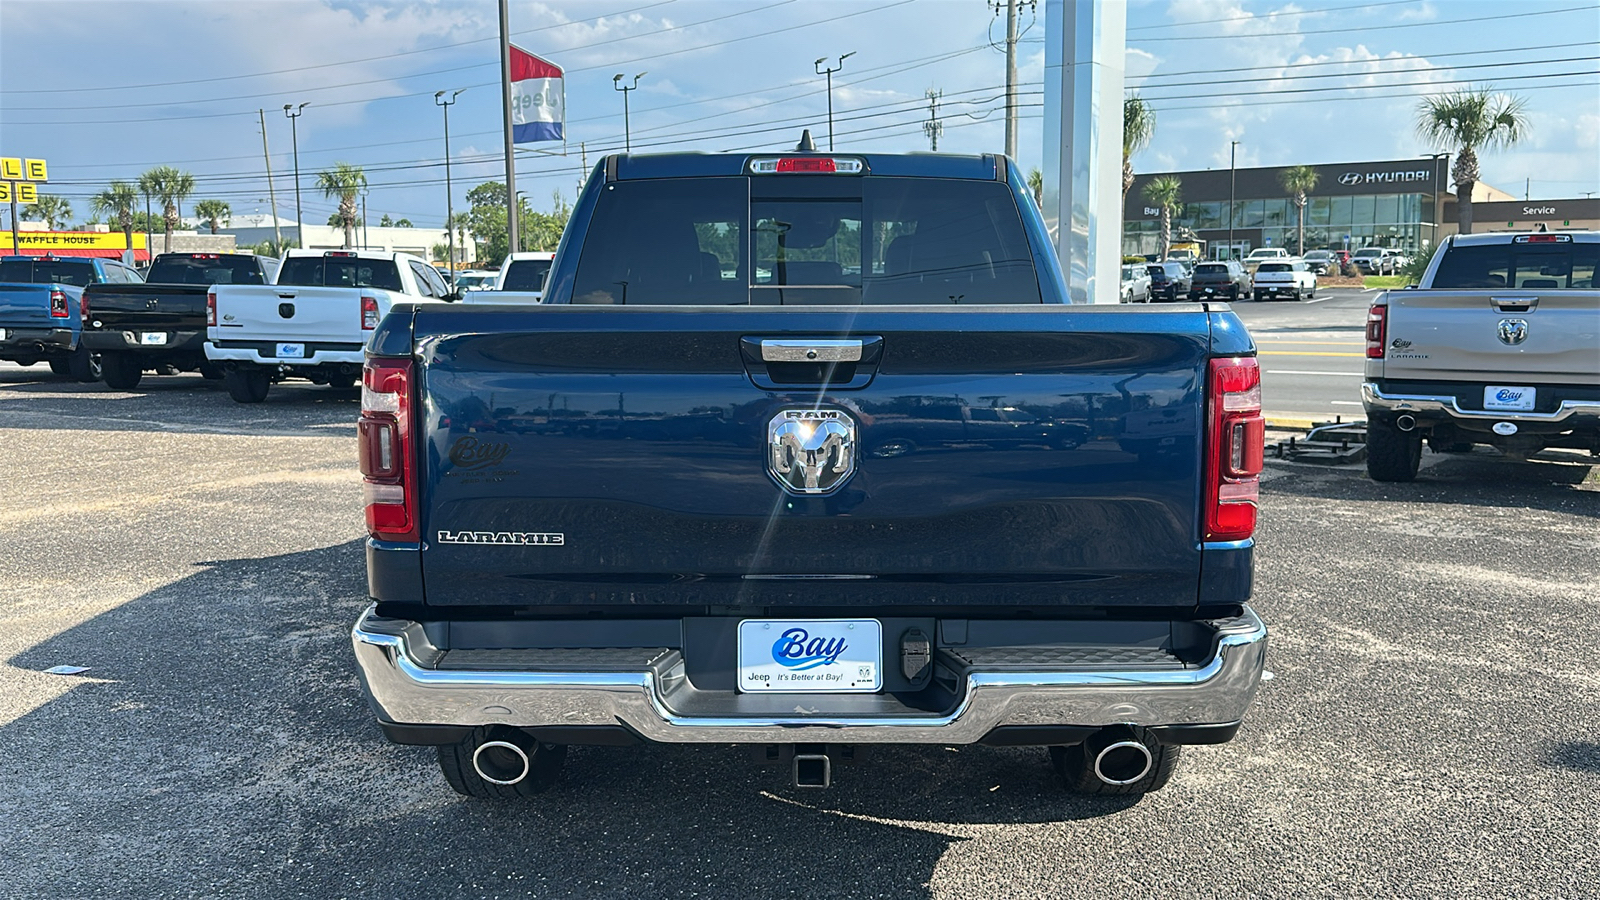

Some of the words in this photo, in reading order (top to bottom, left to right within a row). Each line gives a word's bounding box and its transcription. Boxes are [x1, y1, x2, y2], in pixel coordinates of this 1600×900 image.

[1365, 171, 1430, 183] HYUNDAI
[1144, 207, 1159, 216] Bay
[1522, 206, 1556, 215] Service
[18, 236, 59, 244] WAFFLE
[63, 236, 95, 244] HOUSE
[1496, 389, 1523, 402] Bay
[786, 411, 838, 419] RAM
[450, 436, 513, 468] Bay
[438, 531, 564, 545] LARAMIE
[774, 628, 848, 667] Bay
[748, 673, 770, 681] Jeep
[825, 674, 843, 682] Bay!
